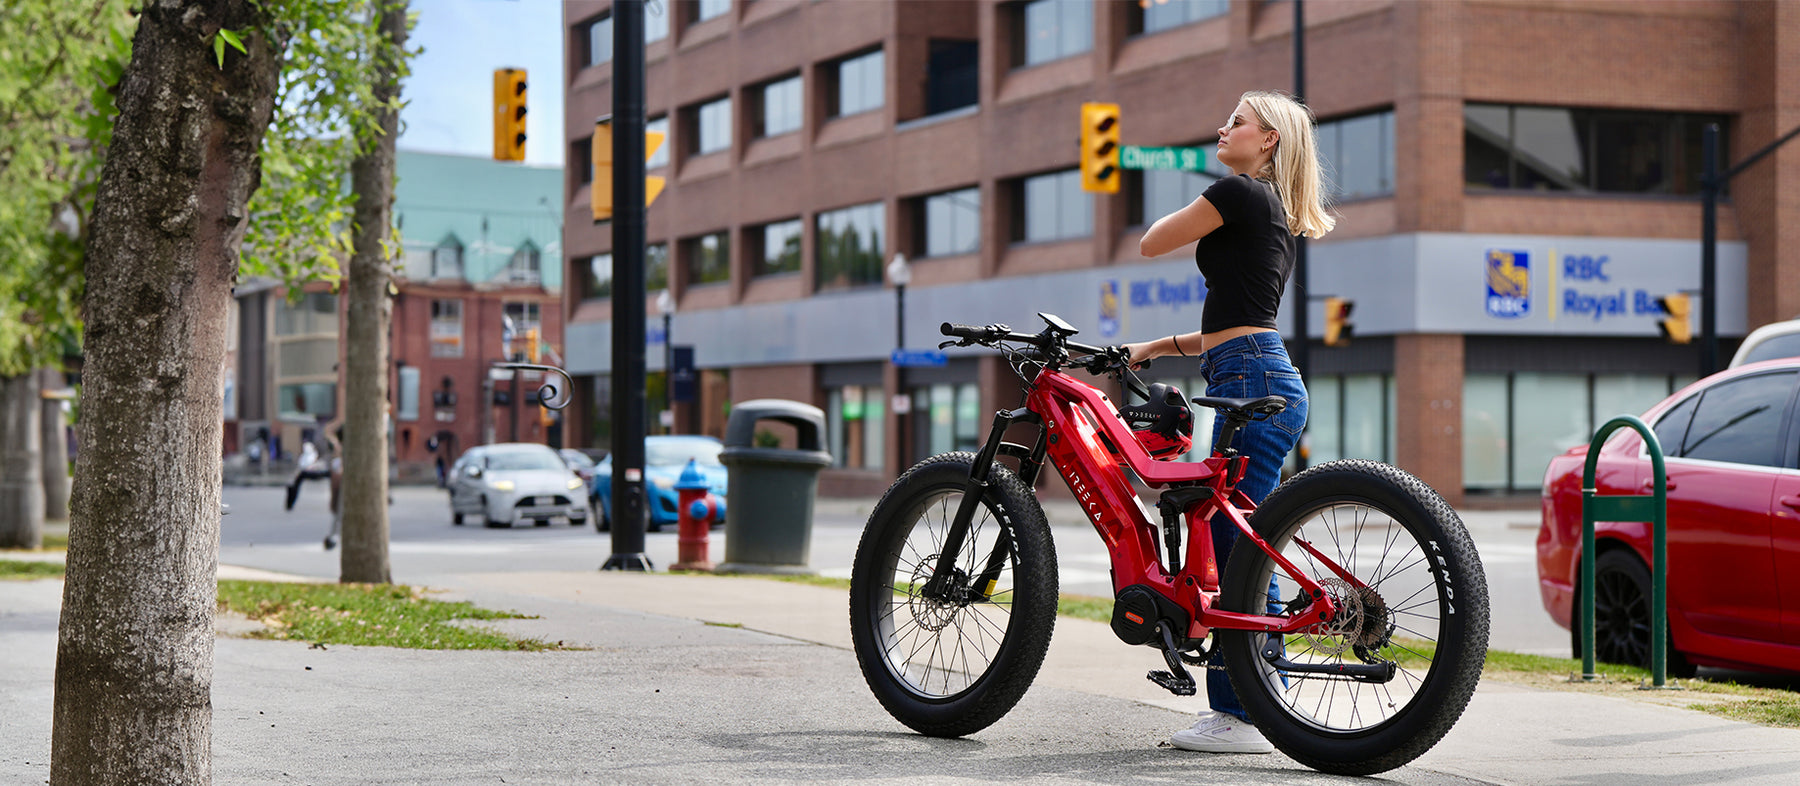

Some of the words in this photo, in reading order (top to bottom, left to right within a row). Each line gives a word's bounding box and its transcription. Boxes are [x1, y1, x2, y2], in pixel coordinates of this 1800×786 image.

[1122, 145, 1176, 169] Church
[1181, 148, 1197, 170] St
[1563, 256, 1610, 281] RBC
[1488, 296, 1525, 313] RBC
[1563, 289, 1626, 321] Royal
[1634, 289, 1663, 314] Ba
[996, 503, 1021, 566] KENDA
[1429, 540, 1455, 614] KENDA
